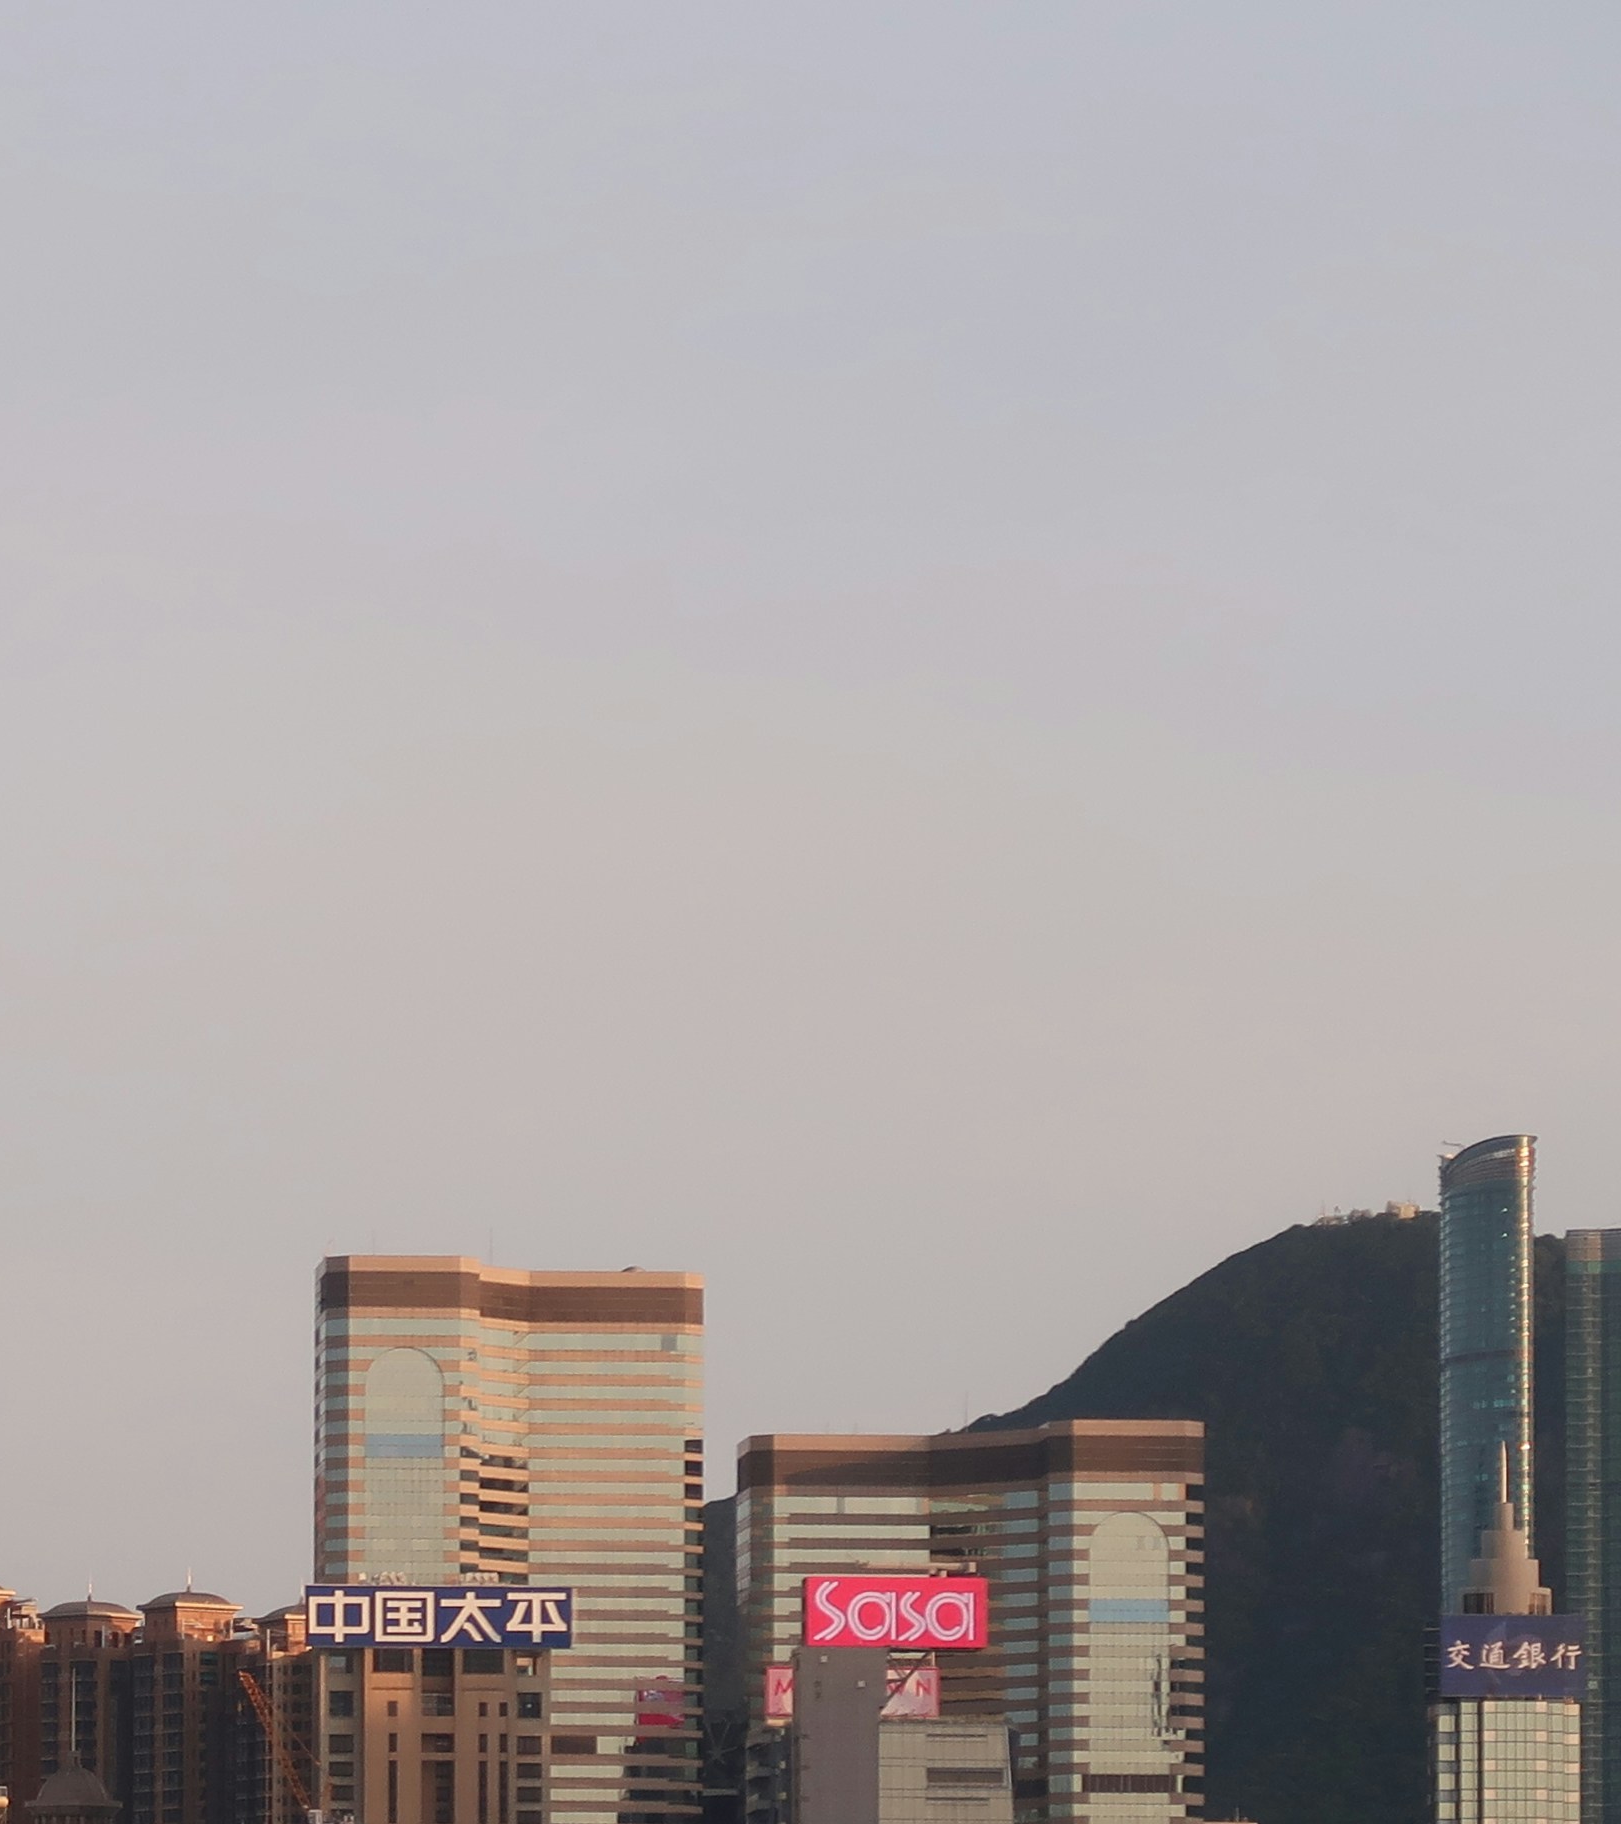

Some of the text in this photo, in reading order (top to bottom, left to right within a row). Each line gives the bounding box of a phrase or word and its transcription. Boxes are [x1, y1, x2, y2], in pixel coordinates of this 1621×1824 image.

[308, 1590, 568, 1643] 中国太平
[1445, 1640, 1582, 1670] 交通銀行
